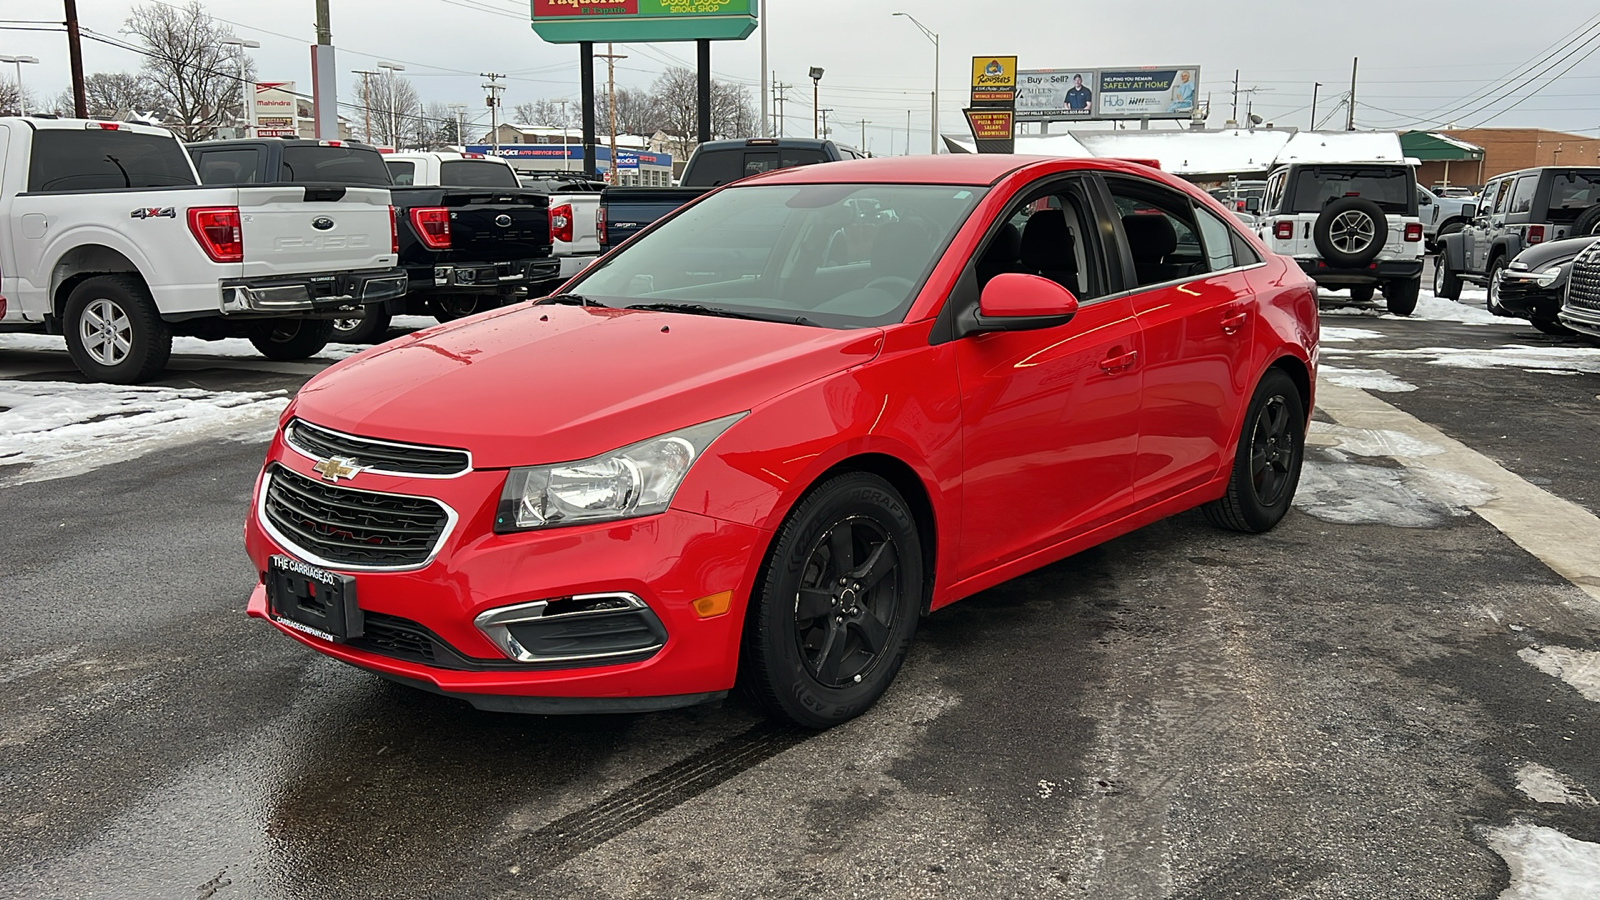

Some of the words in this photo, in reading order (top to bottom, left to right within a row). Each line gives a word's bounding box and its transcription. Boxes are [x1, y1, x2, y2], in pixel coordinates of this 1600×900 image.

[592, 6, 626, 15] Tapatio
[670, 5, 696, 13] SMOKE
[976, 73, 1011, 85] Roosters
[1027, 76, 1043, 84] Buy
[1050, 75, 1069, 83] Sell?
[1102, 82, 1131, 90] SAFELY
[1144, 81, 1169, 89] HOME
[273, 556, 289, 571] THE
[289, 559, 324, 582] CARRIAGE
[322, 571, 336, 586] CO.
[276, 616, 334, 643] CARRIAGECOMPANY.COM
